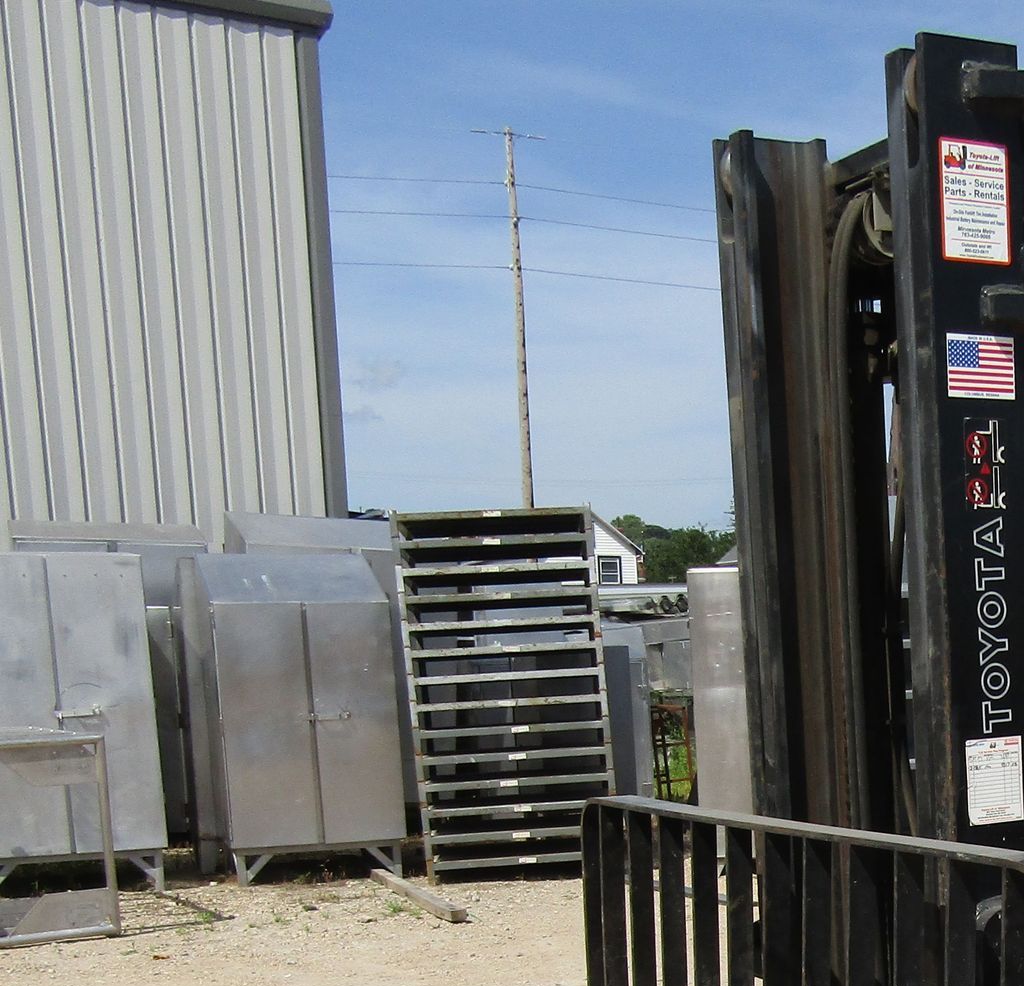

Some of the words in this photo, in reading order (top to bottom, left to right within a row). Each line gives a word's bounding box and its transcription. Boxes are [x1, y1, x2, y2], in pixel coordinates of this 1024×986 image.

[969, 151, 1000, 162] Toyota-Lift
[975, 164, 1004, 173] Minnesota
[944, 175, 967, 186] Sales
[974, 178, 1004, 190] Service
[944, 186, 967, 197] Parts
[974, 189, 1005, 201] Rentals
[973, 516, 1012, 734] TOYOTA
